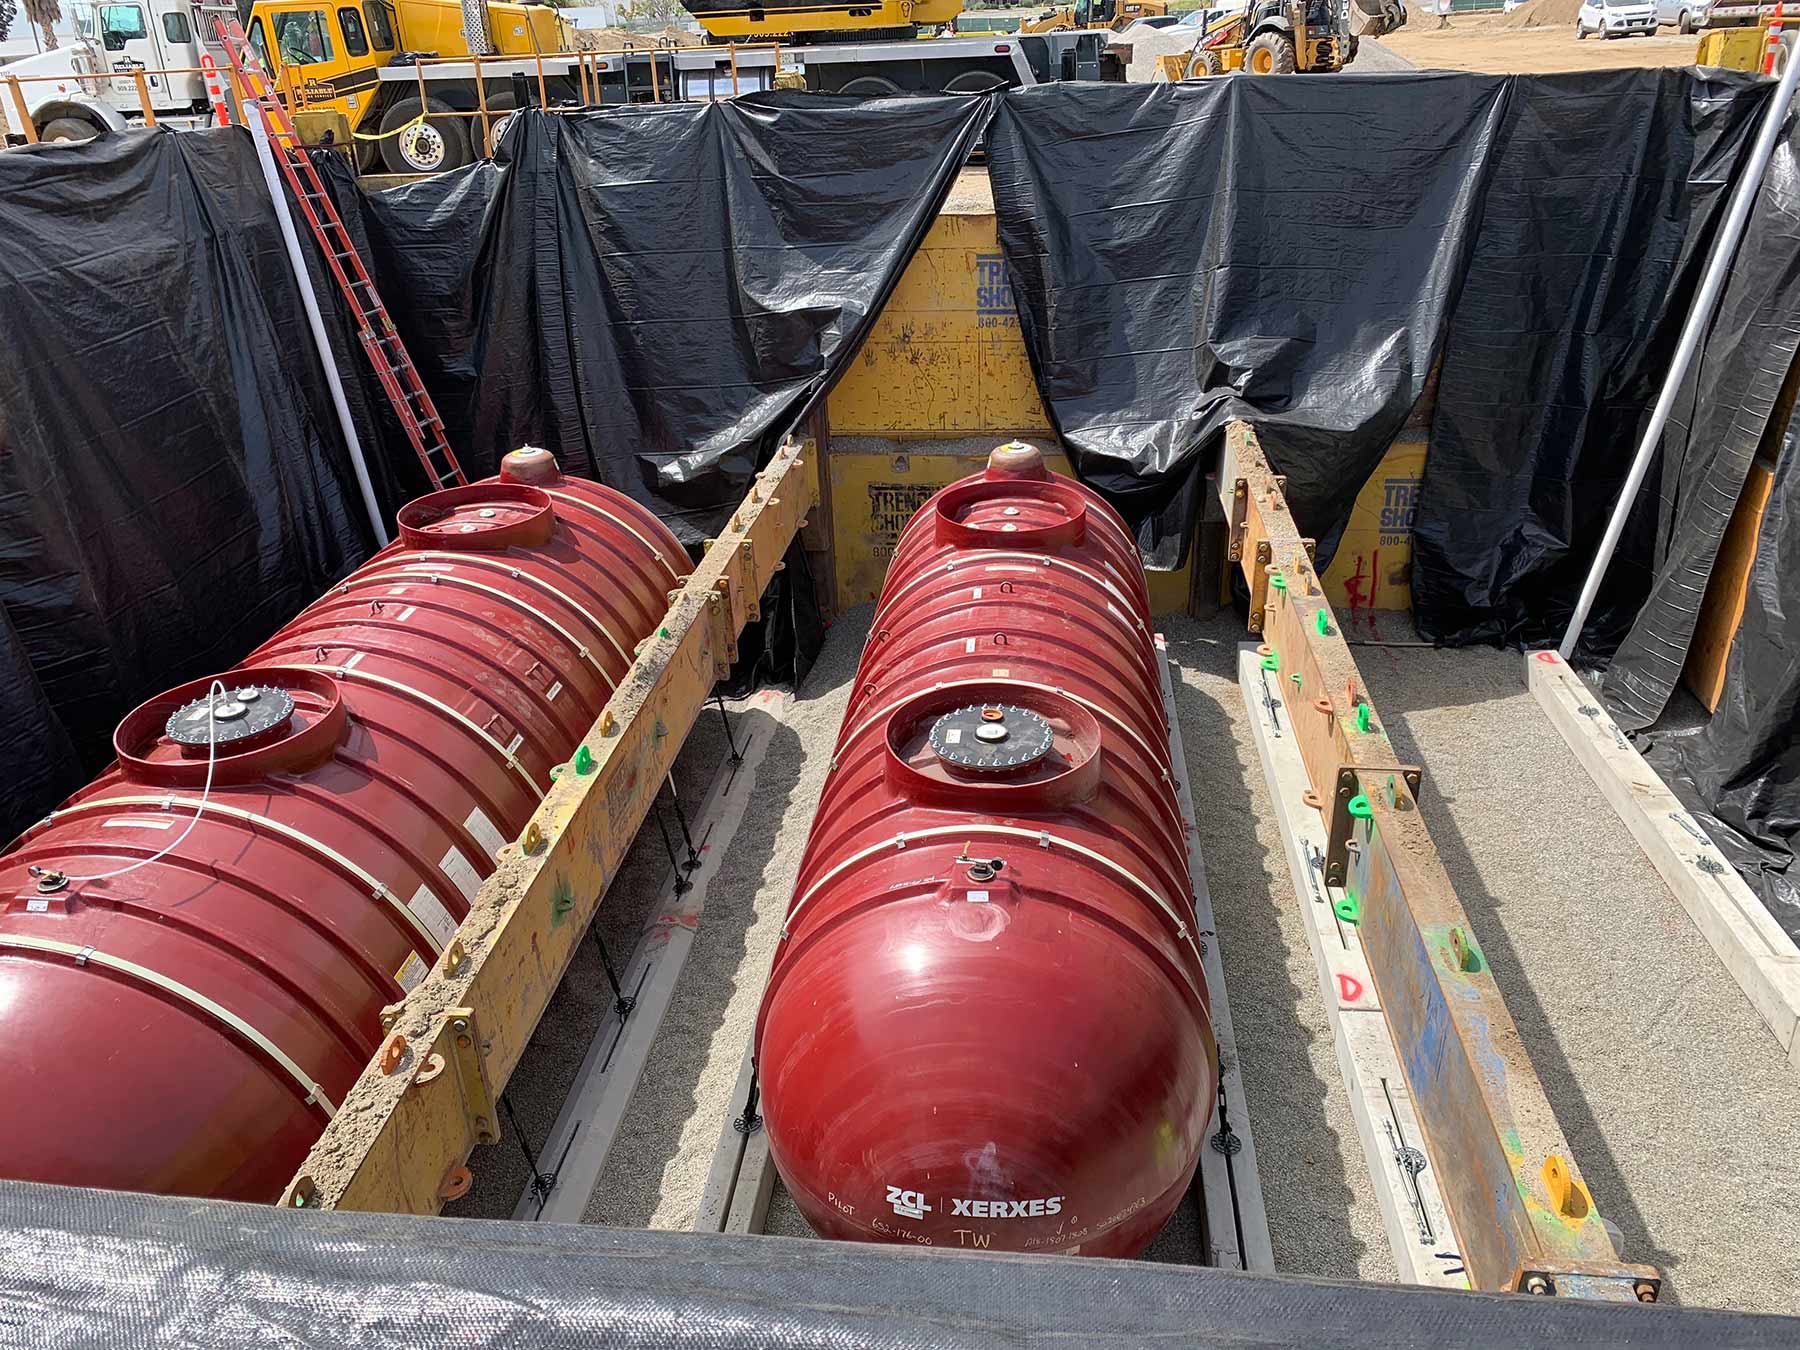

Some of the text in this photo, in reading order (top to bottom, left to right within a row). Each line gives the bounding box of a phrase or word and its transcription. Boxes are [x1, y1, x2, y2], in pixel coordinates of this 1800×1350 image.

[1335, 973, 1363, 1002] D
[828, 1191, 856, 1216] PILOT
[886, 1184, 932, 1212] ZCL
[951, 1196, 1063, 1218] XERXES
[953, 1229, 990, 1249] TW
